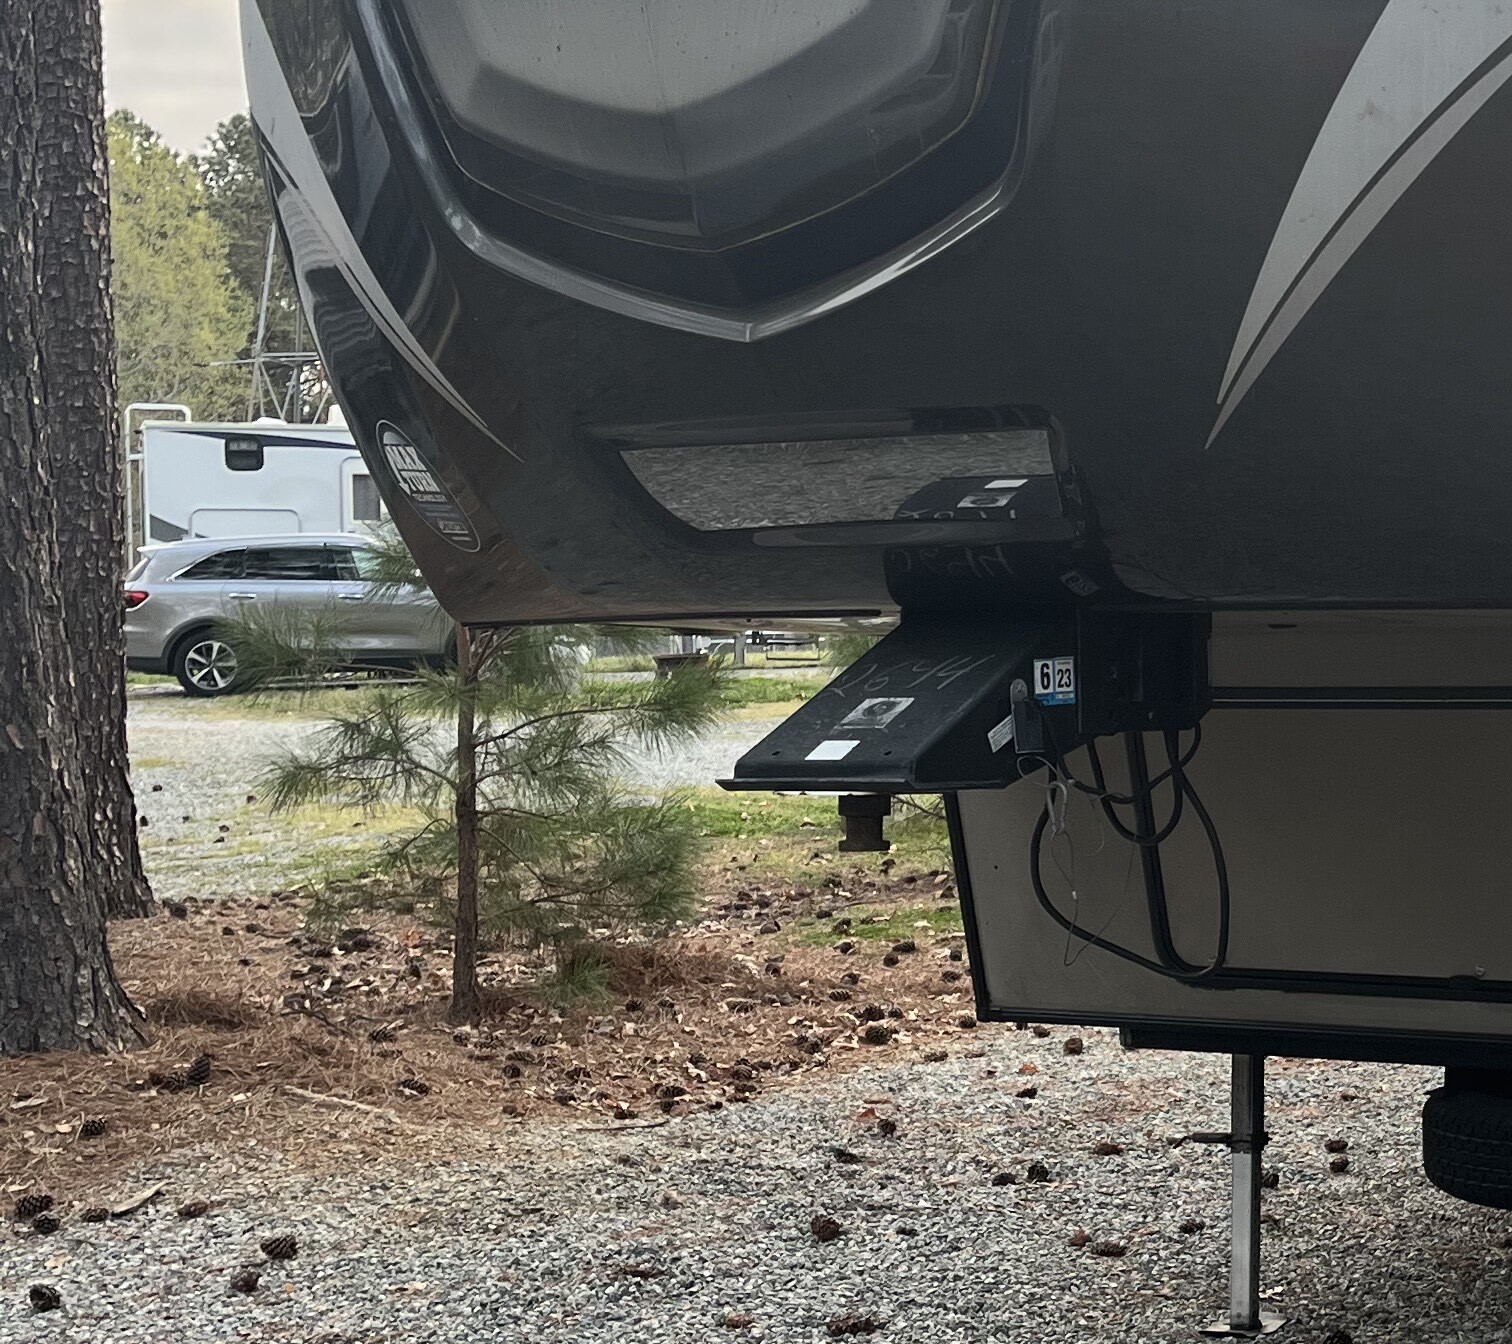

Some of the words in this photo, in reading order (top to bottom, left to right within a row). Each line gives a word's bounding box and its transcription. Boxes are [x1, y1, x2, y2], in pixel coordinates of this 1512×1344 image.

[385, 445, 427, 471] MAX
[400, 471, 441, 492] TURN
[1040, 662, 1051, 690] 6
[1056, 667, 1072, 688] 23
